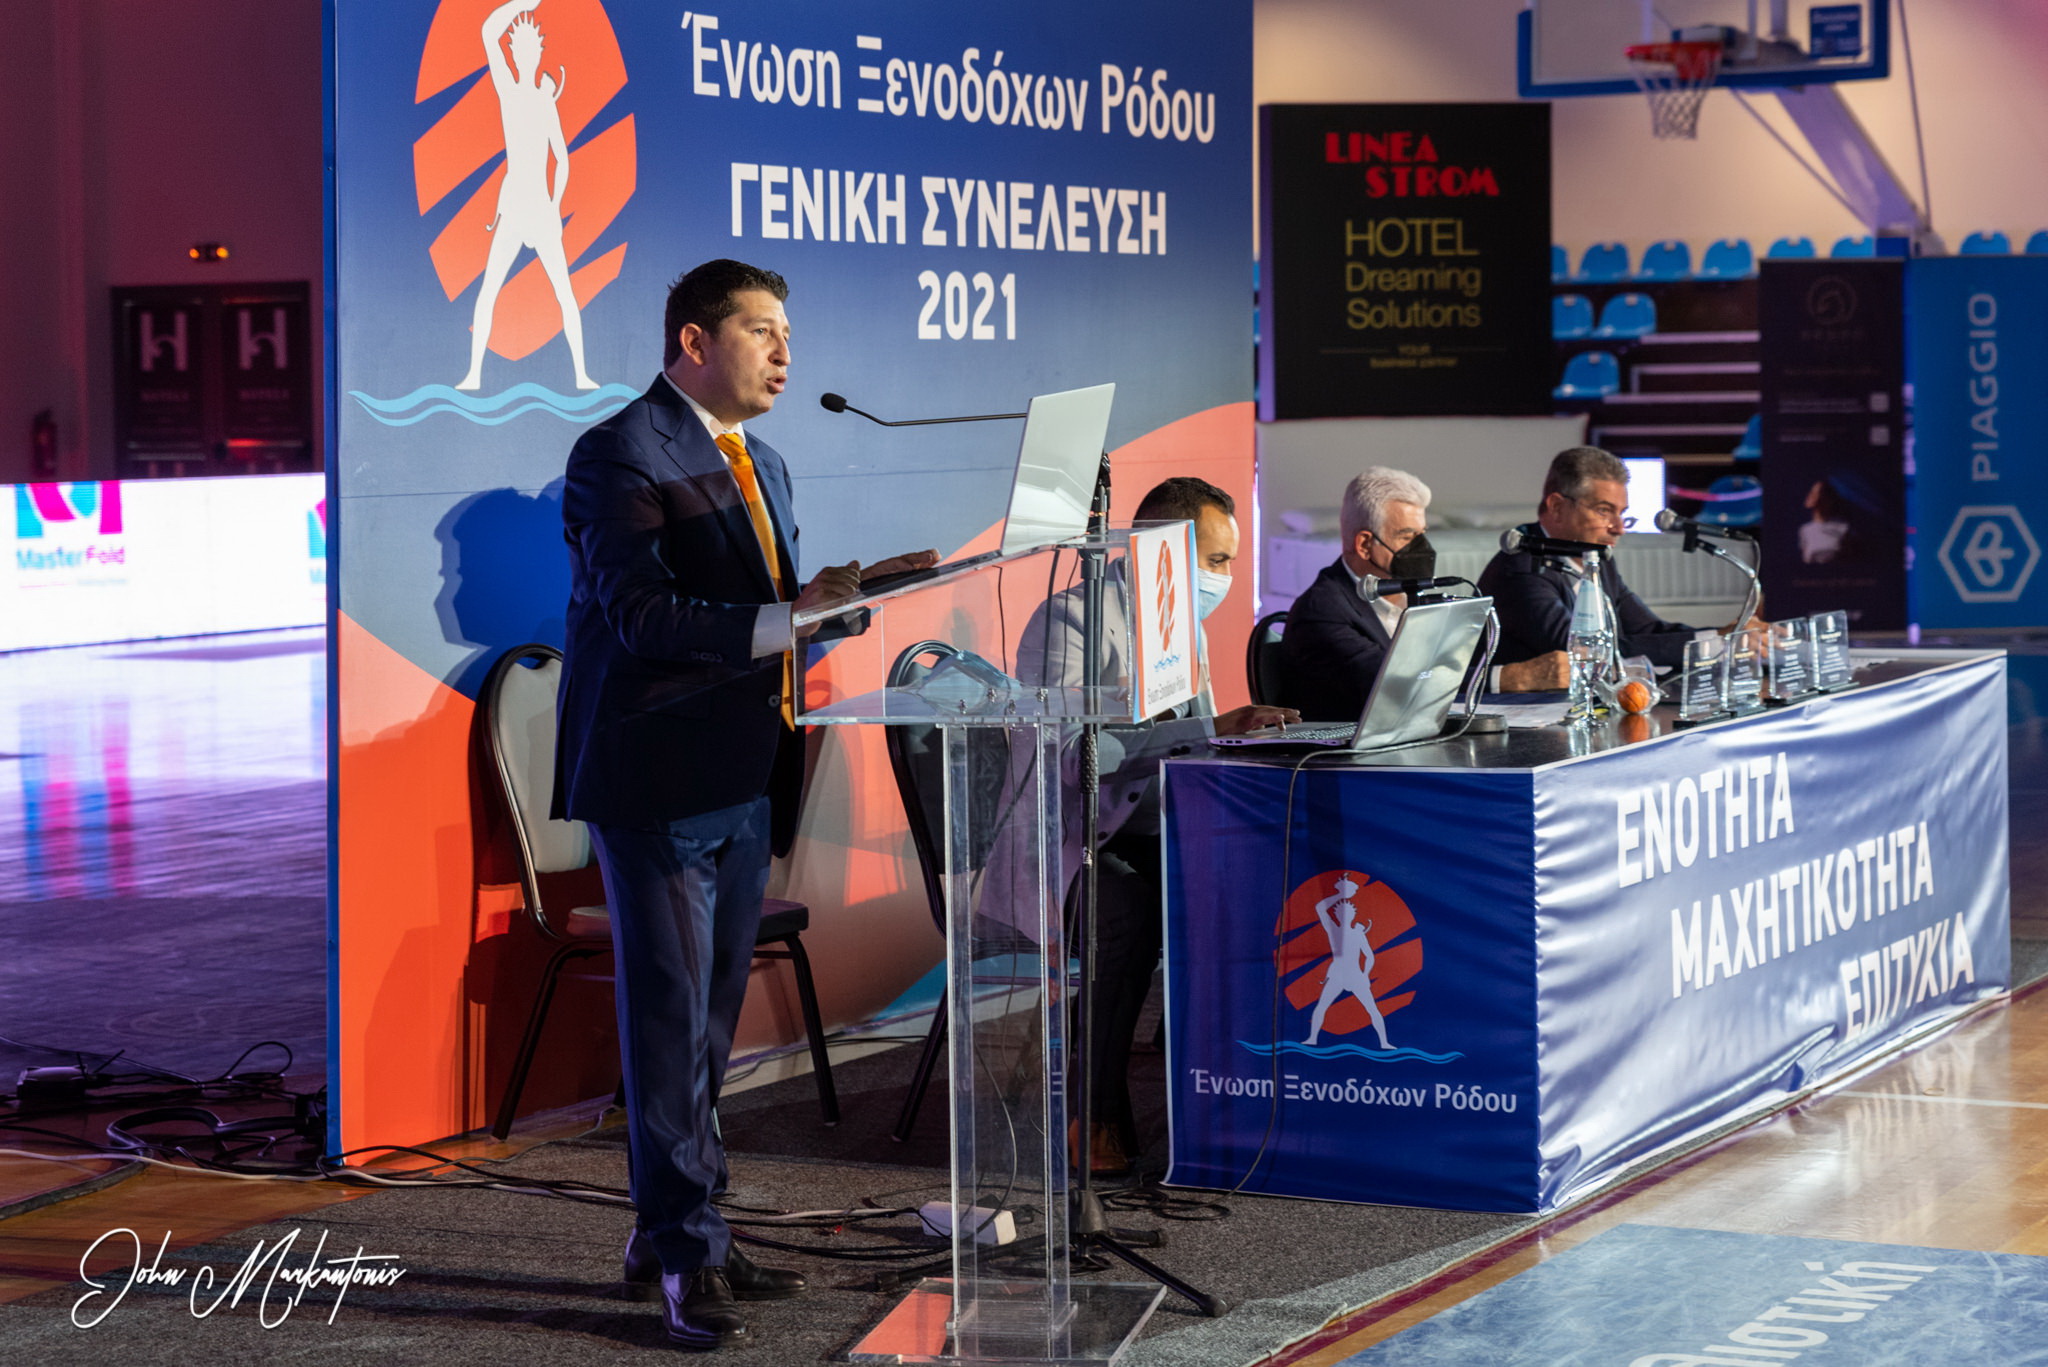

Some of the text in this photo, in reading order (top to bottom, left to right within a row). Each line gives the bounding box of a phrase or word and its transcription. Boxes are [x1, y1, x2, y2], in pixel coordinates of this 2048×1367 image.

[681, 11, 1216, 143] Ένωση Ξενοδόχων Ρόδου
[1325, 132, 1439, 163] LINEA
[1365, 166, 1500, 198] STROM
[731, 162, 1167, 255] ΓΕΝΙΚΗ ΣΥΝΕΛΕΥΣΗ
[1345, 217, 1480, 257] HOTEL
[917, 270, 1016, 340] 2021
[1345, 261, 1482, 297] Dreaming
[1347, 298, 1482, 329] Solutions
[1967, 293, 1999, 482] PIAGGIO
[1617, 752, 1795, 889] ΕΝΟΤΗΤΑ
[1671, 821, 1935, 999] ΜΑΧΗΤΙΚΟΤΗΤΑ
[1840, 911, 1976, 1041] ΕΠΙΤΥΧΙΑ
[1190, 1068, 1517, 1113] Ένωση Ξενοδόχων Ρόδου
